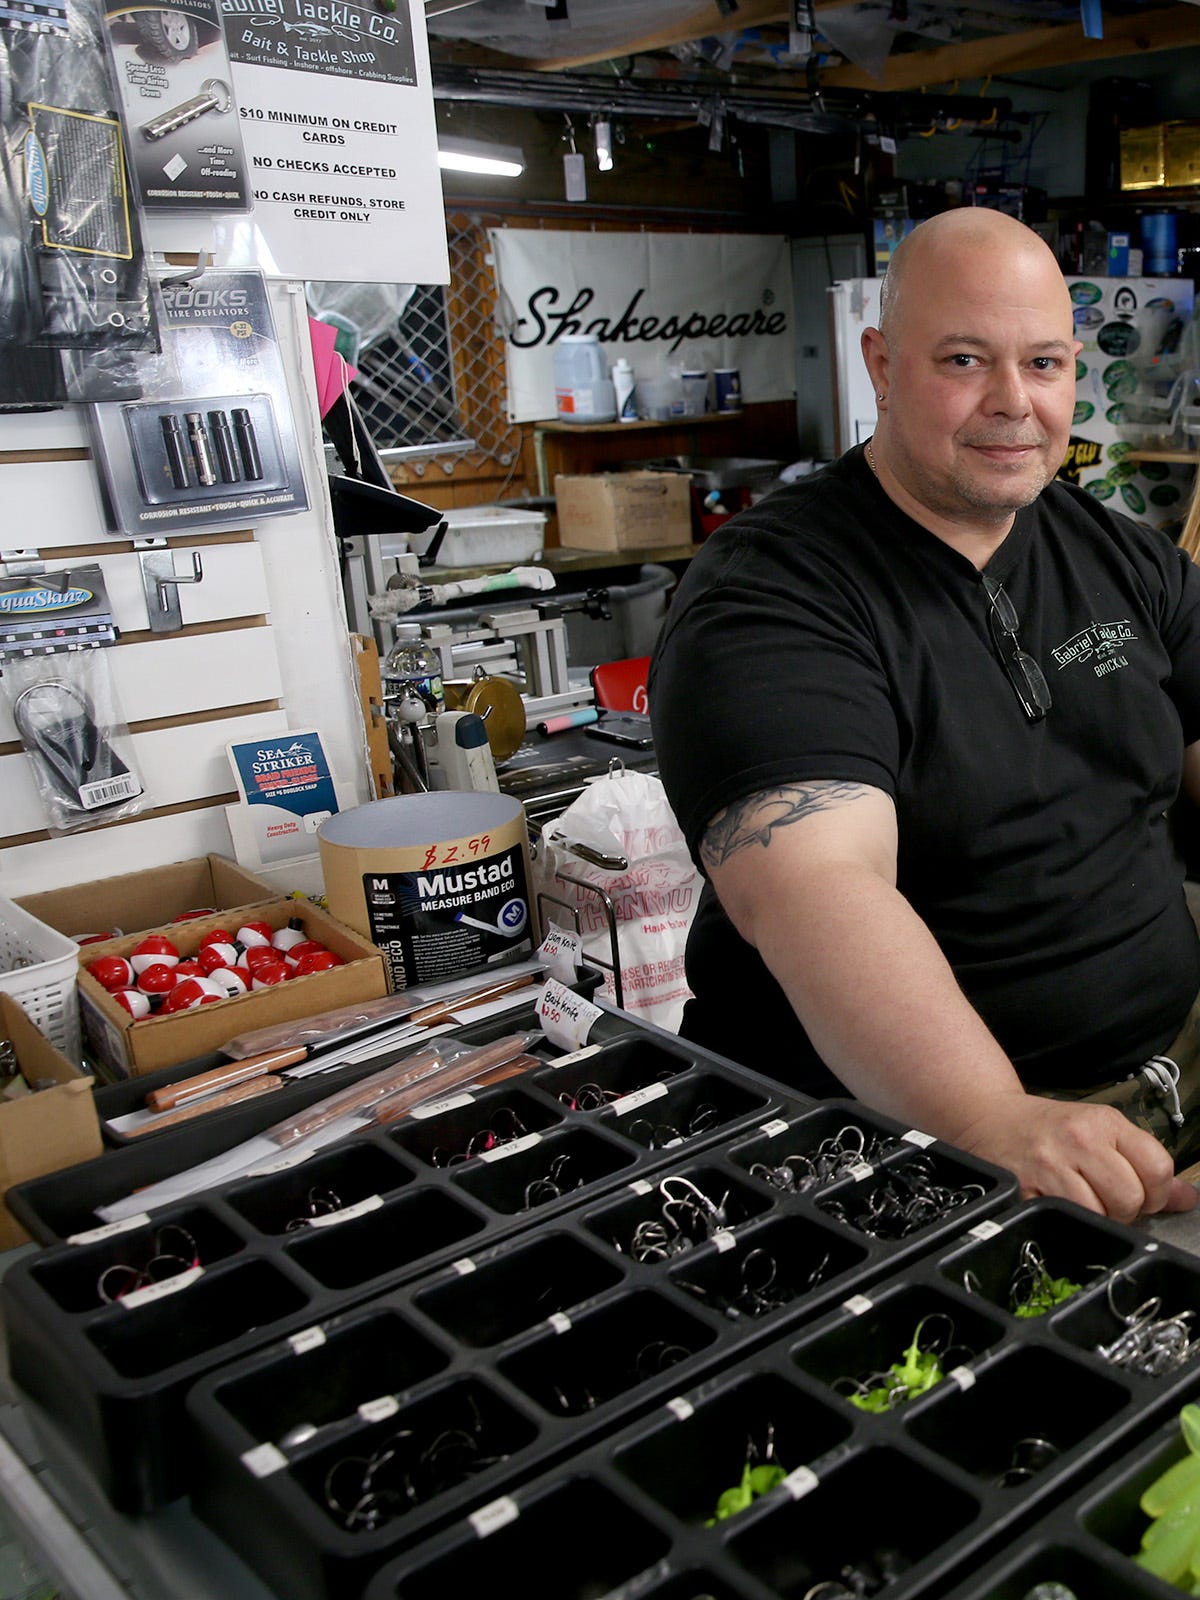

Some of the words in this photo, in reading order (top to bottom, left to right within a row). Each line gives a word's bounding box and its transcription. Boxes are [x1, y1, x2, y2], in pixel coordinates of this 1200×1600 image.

[222, 0, 285, 14] abriel
[296, 0, 361, 29] Tackle
[369, 15, 399, 43] Co.
[241, 29, 273, 51] Bait
[277, 42, 290, 56] &
[294, 46, 339, 64] Tackle
[342, 51, 376, 65] Shop
[126, 61, 149, 74] Spend
[149, 65, 166, 75] Less
[246, 53, 261, 62] Surf
[262, 55, 288, 67] Fishing
[294, 61, 319, 71] Inshore
[325, 64, 352, 75] offshore
[359, 69, 386, 81] Crabbing
[387, 73, 414, 84] Supplies
[128, 74, 146, 85] Time
[147, 75, 169, 89] Airing
[140, 87, 161, 98] Down
[240, 107, 264, 119] $10
[268, 110, 329, 127] MINIMUM
[332, 118, 350, 129] ON
[354, 121, 398, 134] CREDIT
[303, 131, 346, 145] CARDS
[209, 157, 225, 166] Time
[253, 156, 273, 167] NO
[277, 159, 330, 173] CHECKS
[333, 164, 396, 178] ACCEPTED
[253, 190, 269, 199] NO
[272, 191, 305, 202] CASH
[309, 194, 367, 208] REFUNDS,
[369, 199, 406, 209] STORE
[294, 208, 337, 220] CREDIT
[340, 211, 370, 222] ONLY
[162, 290, 248, 309] ROOKS
[168, 309, 191, 318] TIRE
[194, 307, 250, 317] DEFLATORS
[510, 286, 787, 353] Shakespeare
[139, 509, 179, 520] CORROSION
[0, 590, 85, 612] quaSkinz
[1053, 633, 1093, 664] Gabriel
[1117, 624, 1134, 637] Co.
[1093, 658, 1122, 678] BRICK
[252, 755, 315, 774] STRIKER
[257, 748, 286, 762] SEA
[265, 790, 276, 798] SIZE
[266, 827, 299, 838] Construction
[419, 835, 491, 871] $2.99
[372, 879, 390, 890] M
[416, 855, 514, 898] Mustad
[421, 894, 473, 912] MEASURE
[474, 886, 500, 902] BAND
[501, 879, 515, 892] ECO
[504, 905, 521, 922] M
[389, 940, 404, 962] ECO
[561, 936, 577, 951] Knife
[393, 966, 408, 991] AND
[544, 991, 561, 1007] Bait
[560, 1001, 579, 1022] Knife
